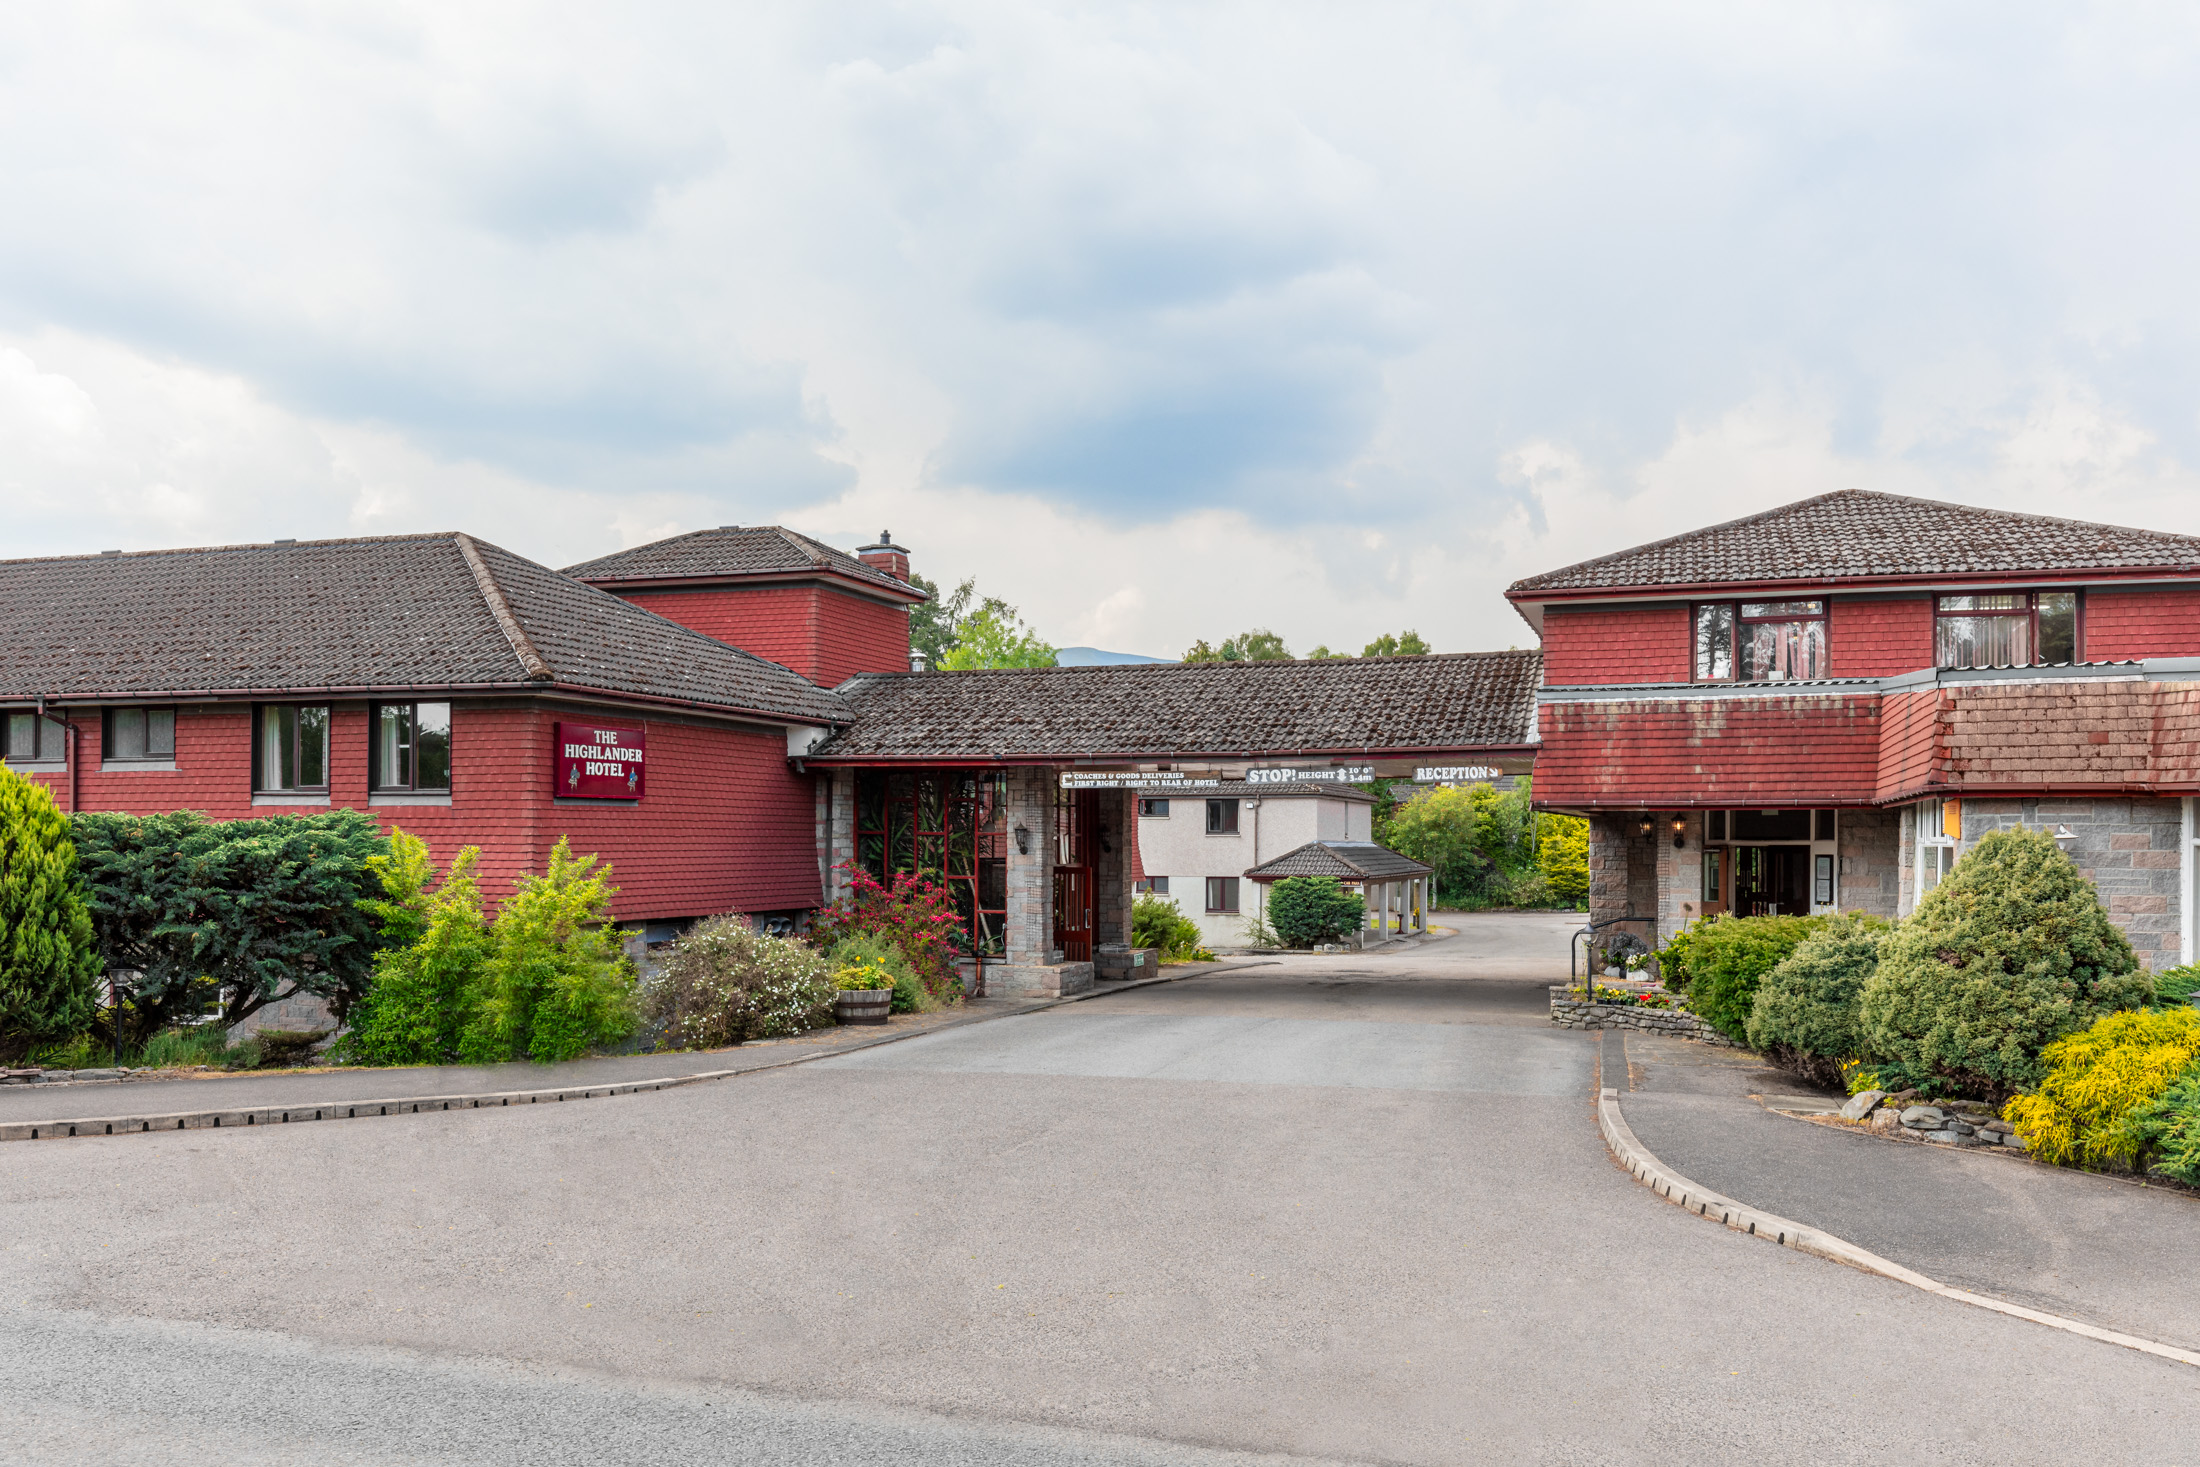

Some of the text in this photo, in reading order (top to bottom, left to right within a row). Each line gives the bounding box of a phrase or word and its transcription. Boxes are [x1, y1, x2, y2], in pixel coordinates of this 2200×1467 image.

[593, 730, 618, 745] THE
[564, 743, 643, 763] HIGHLANDER
[585, 761, 625, 777] HOTEL
[1249, 768, 1336, 783] STOP! HEIGHT
[1416, 766, 1488, 780] RECEPTION
